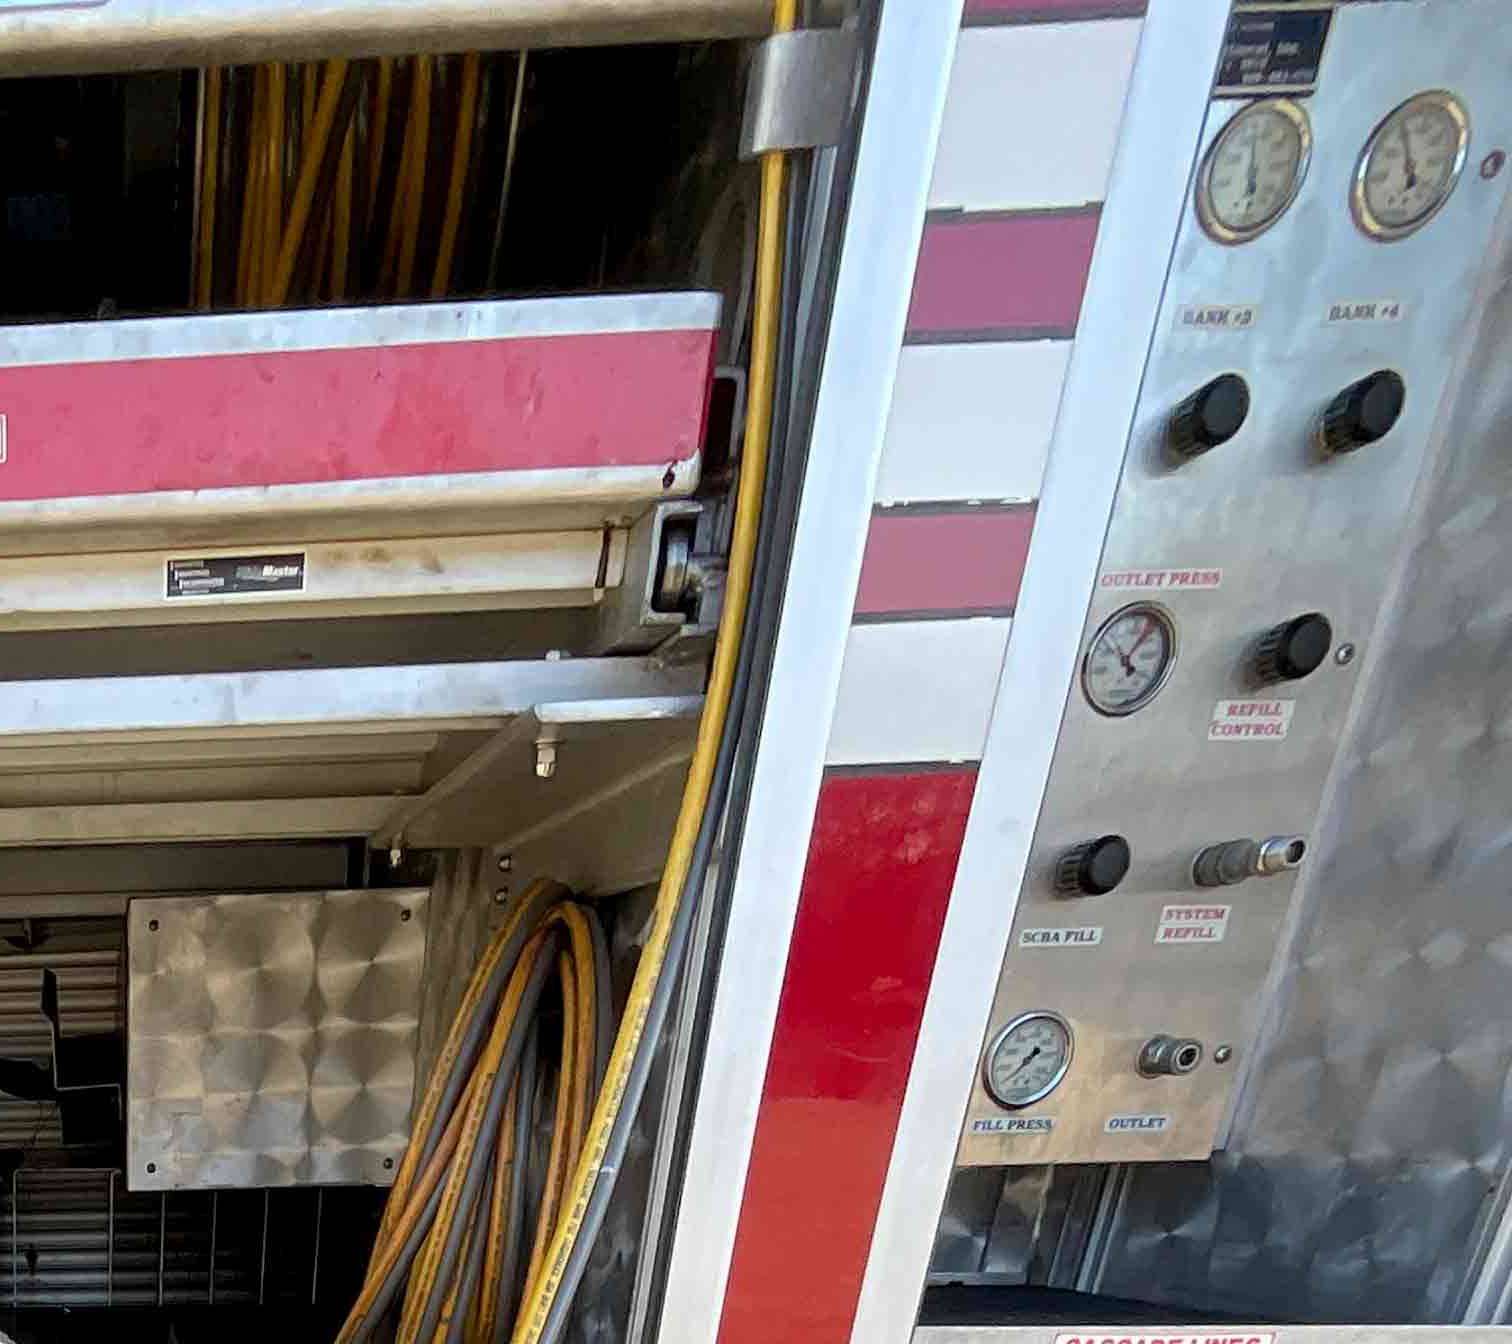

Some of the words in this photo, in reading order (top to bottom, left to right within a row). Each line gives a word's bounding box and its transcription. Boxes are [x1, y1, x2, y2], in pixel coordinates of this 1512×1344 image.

[1101, 573, 1162, 587] OUTLET
[1168, 571, 1221, 585] PRESS
[1227, 703, 1284, 717] REFILL
[1209, 721, 1285, 737] CONTROL
[1162, 908, 1227, 921] SYSTEM
[1022, 930, 1061, 944] SCBA
[1063, 928, 1097, 943] FILL
[1161, 926, 1217, 939] REFILL
[972, 1119, 1004, 1131] FILL
[1007, 1117, 1053, 1131] PRESS
[1108, 1117, 1167, 1129] OUTLET
